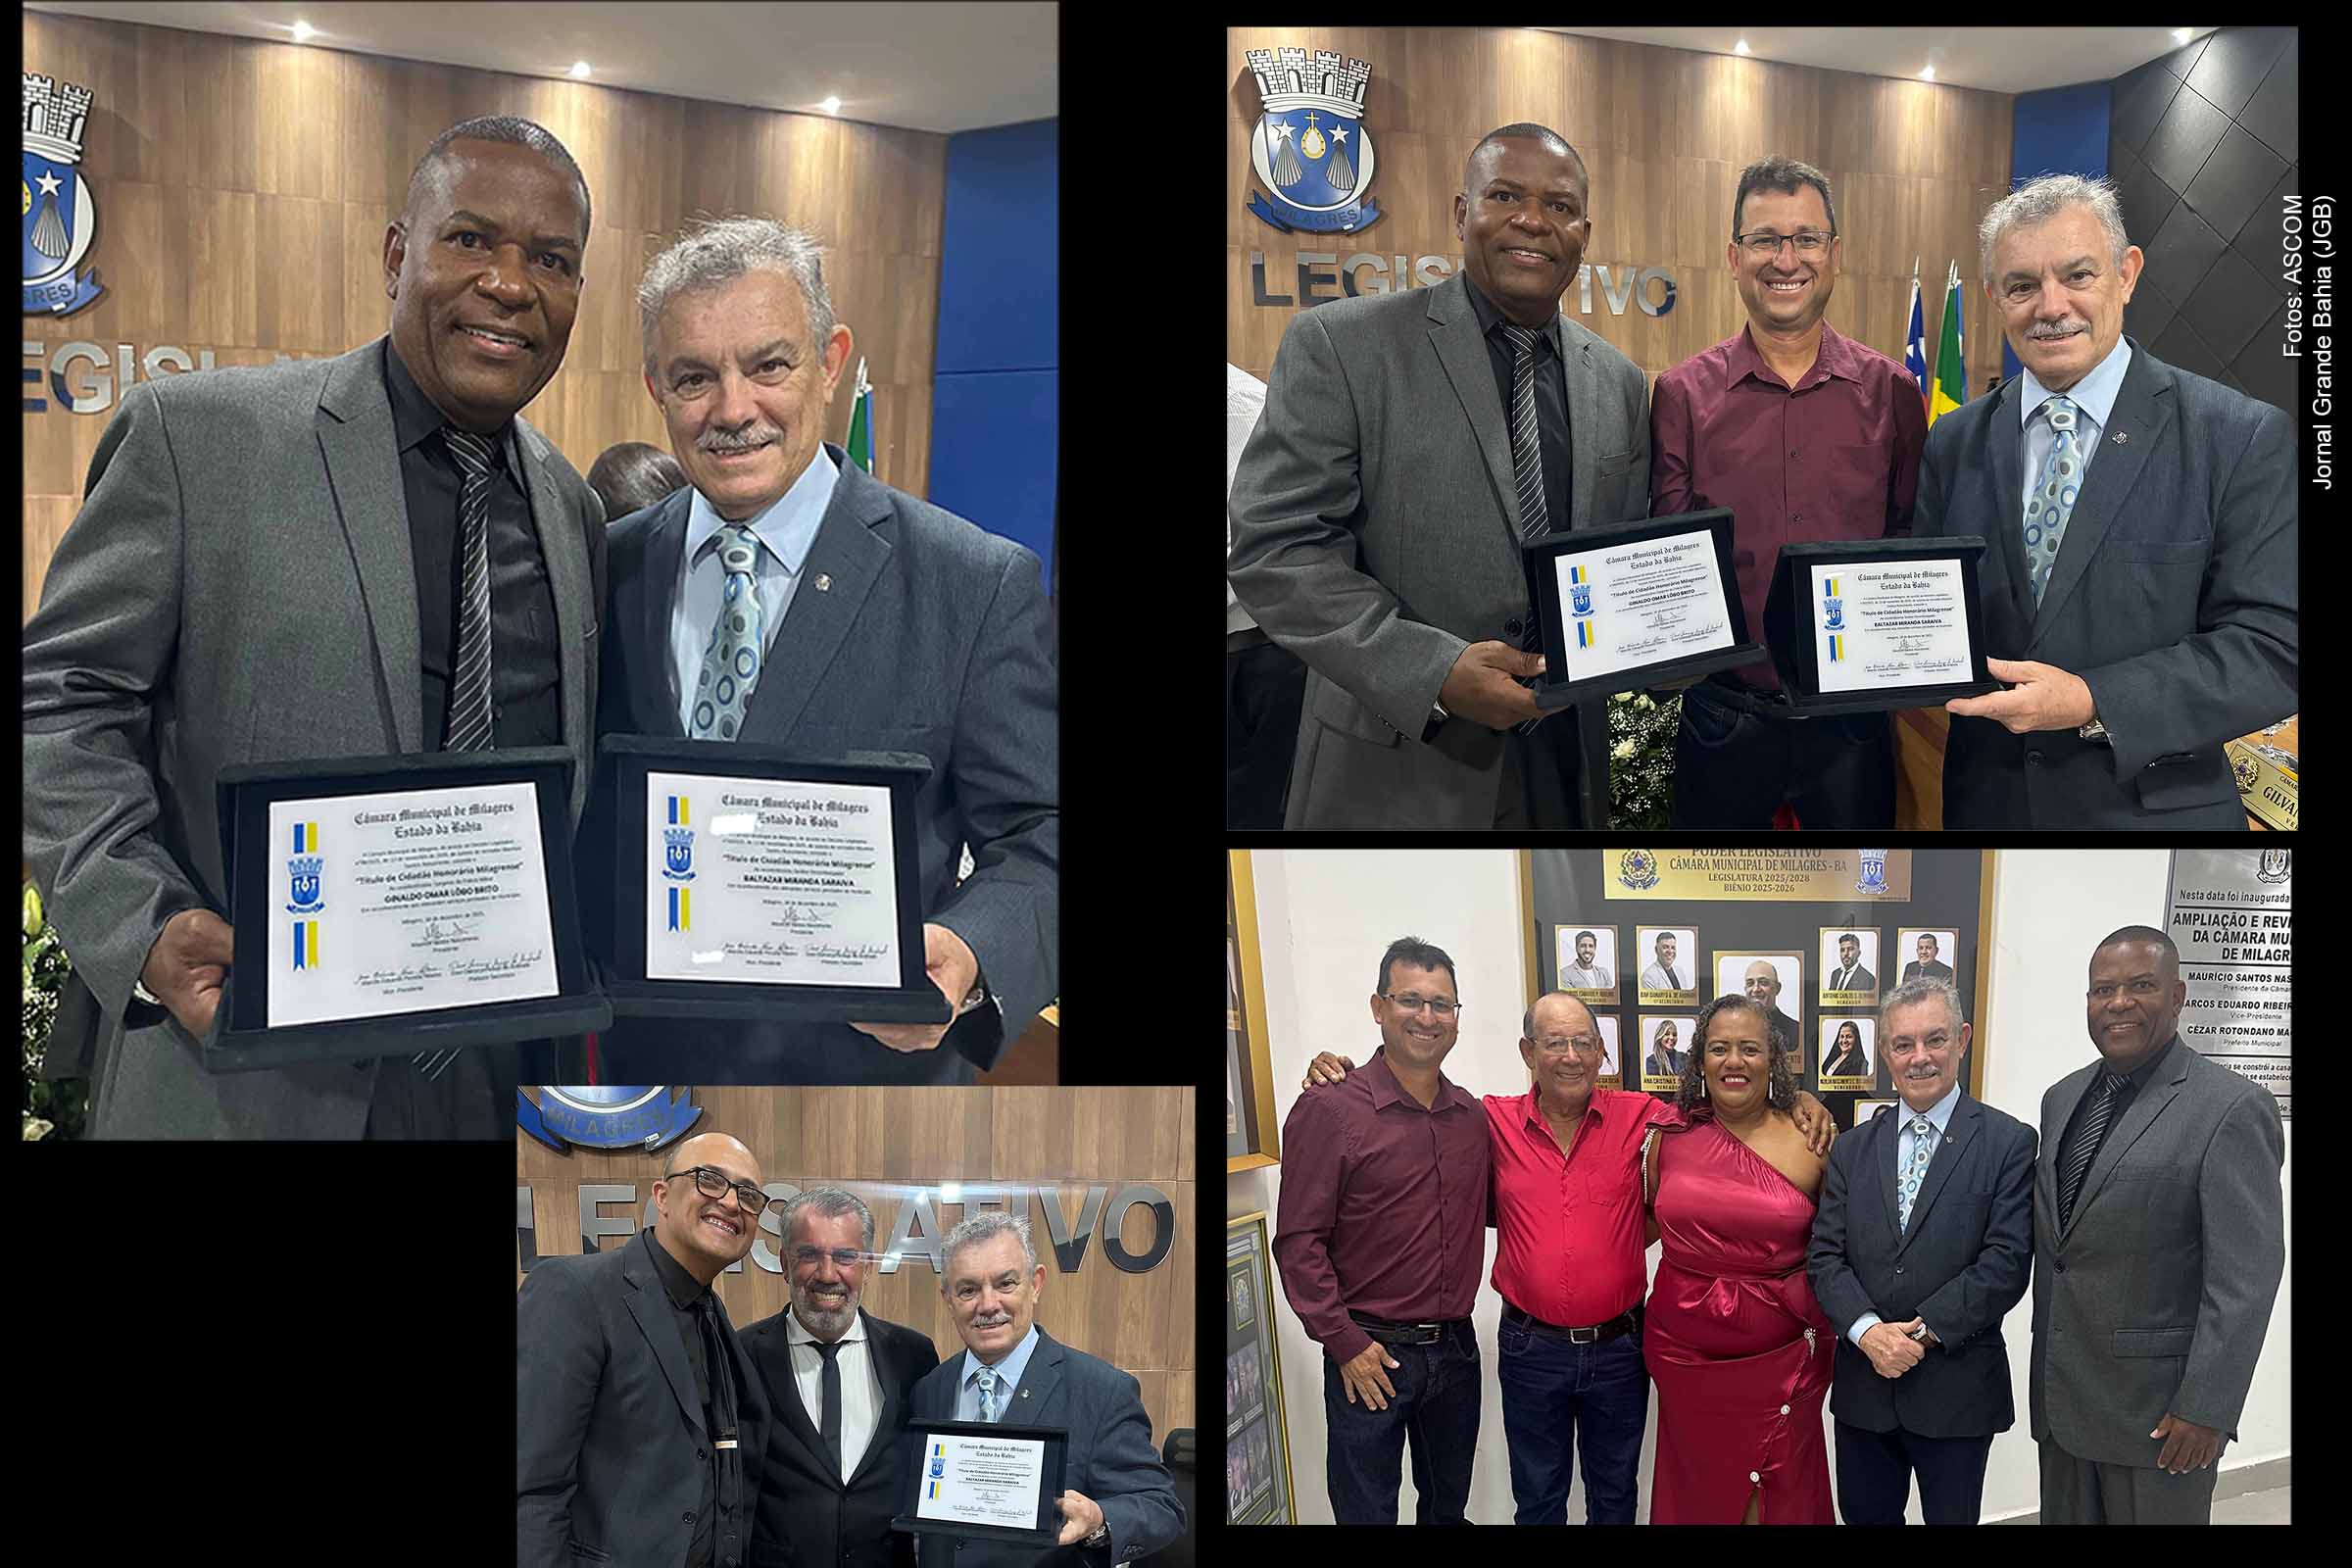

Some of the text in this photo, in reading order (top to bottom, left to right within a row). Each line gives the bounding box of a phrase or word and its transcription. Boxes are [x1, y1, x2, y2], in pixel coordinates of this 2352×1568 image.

[1275, 210, 1357, 225] MILAGRES
[1250, 251, 1677, 317] LEGISIVO
[1606, 555, 1631, 564] Câmara
[1633, 549, 1663, 560] Municipal
[1673, 542, 1699, 553] Milagres
[1631, 561, 1652, 569] Estado
[721, 794, 868, 814] Câmara Municipal de Milagres
[355, 803, 514, 824] Câmara Municipal de Milagres
[758, 811, 839, 828] Estado da Bahia
[395, 821, 482, 839] Estado da Bahia
[1670, 856, 1709, 870] CÂMARA
[1712, 858, 1763, 871] MUNICIPAL
[1766, 859, 1778, 871] DE
[1780, 859, 1827, 871] MILAGRES
[1835, 860, 1847, 871] BA
[386, 873, 396, 882] de
[744, 874, 782, 883] BALTAZAR
[784, 876, 819, 885] MIRANDA
[1708, 873, 1810, 883] LEGISLATURA 2025/2028
[385, 892, 422, 903] GINALDO
[424, 890, 448, 900] OMAR
[474, 885, 499, 894] BRITO
[1724, 883, 1794, 893] BIÊNIO 2025-2026
[2180, 890, 2289, 905] Nesta data foi inaugurada
[2173, 911, 2247, 930] AMPLIAÇÃO
[2251, 915, 2259, 928] E
[2192, 928, 2291, 945] DA CÂMARA MU
[2222, 948, 2238, 959] DE
[2188, 971, 2232, 981] MAURÍCIO
[2235, 974, 2272, 983] SANTOS
[2182, 1000, 2215, 1008] ARCOS
[2218, 1001, 2260, 1009] EDUARDO
[2187, 1024, 2217, 1035] CÉZAR
[2219, 1027, 2275, 1036] ROTONDANO
[2223, 1039, 2249, 1048] Prefeito
